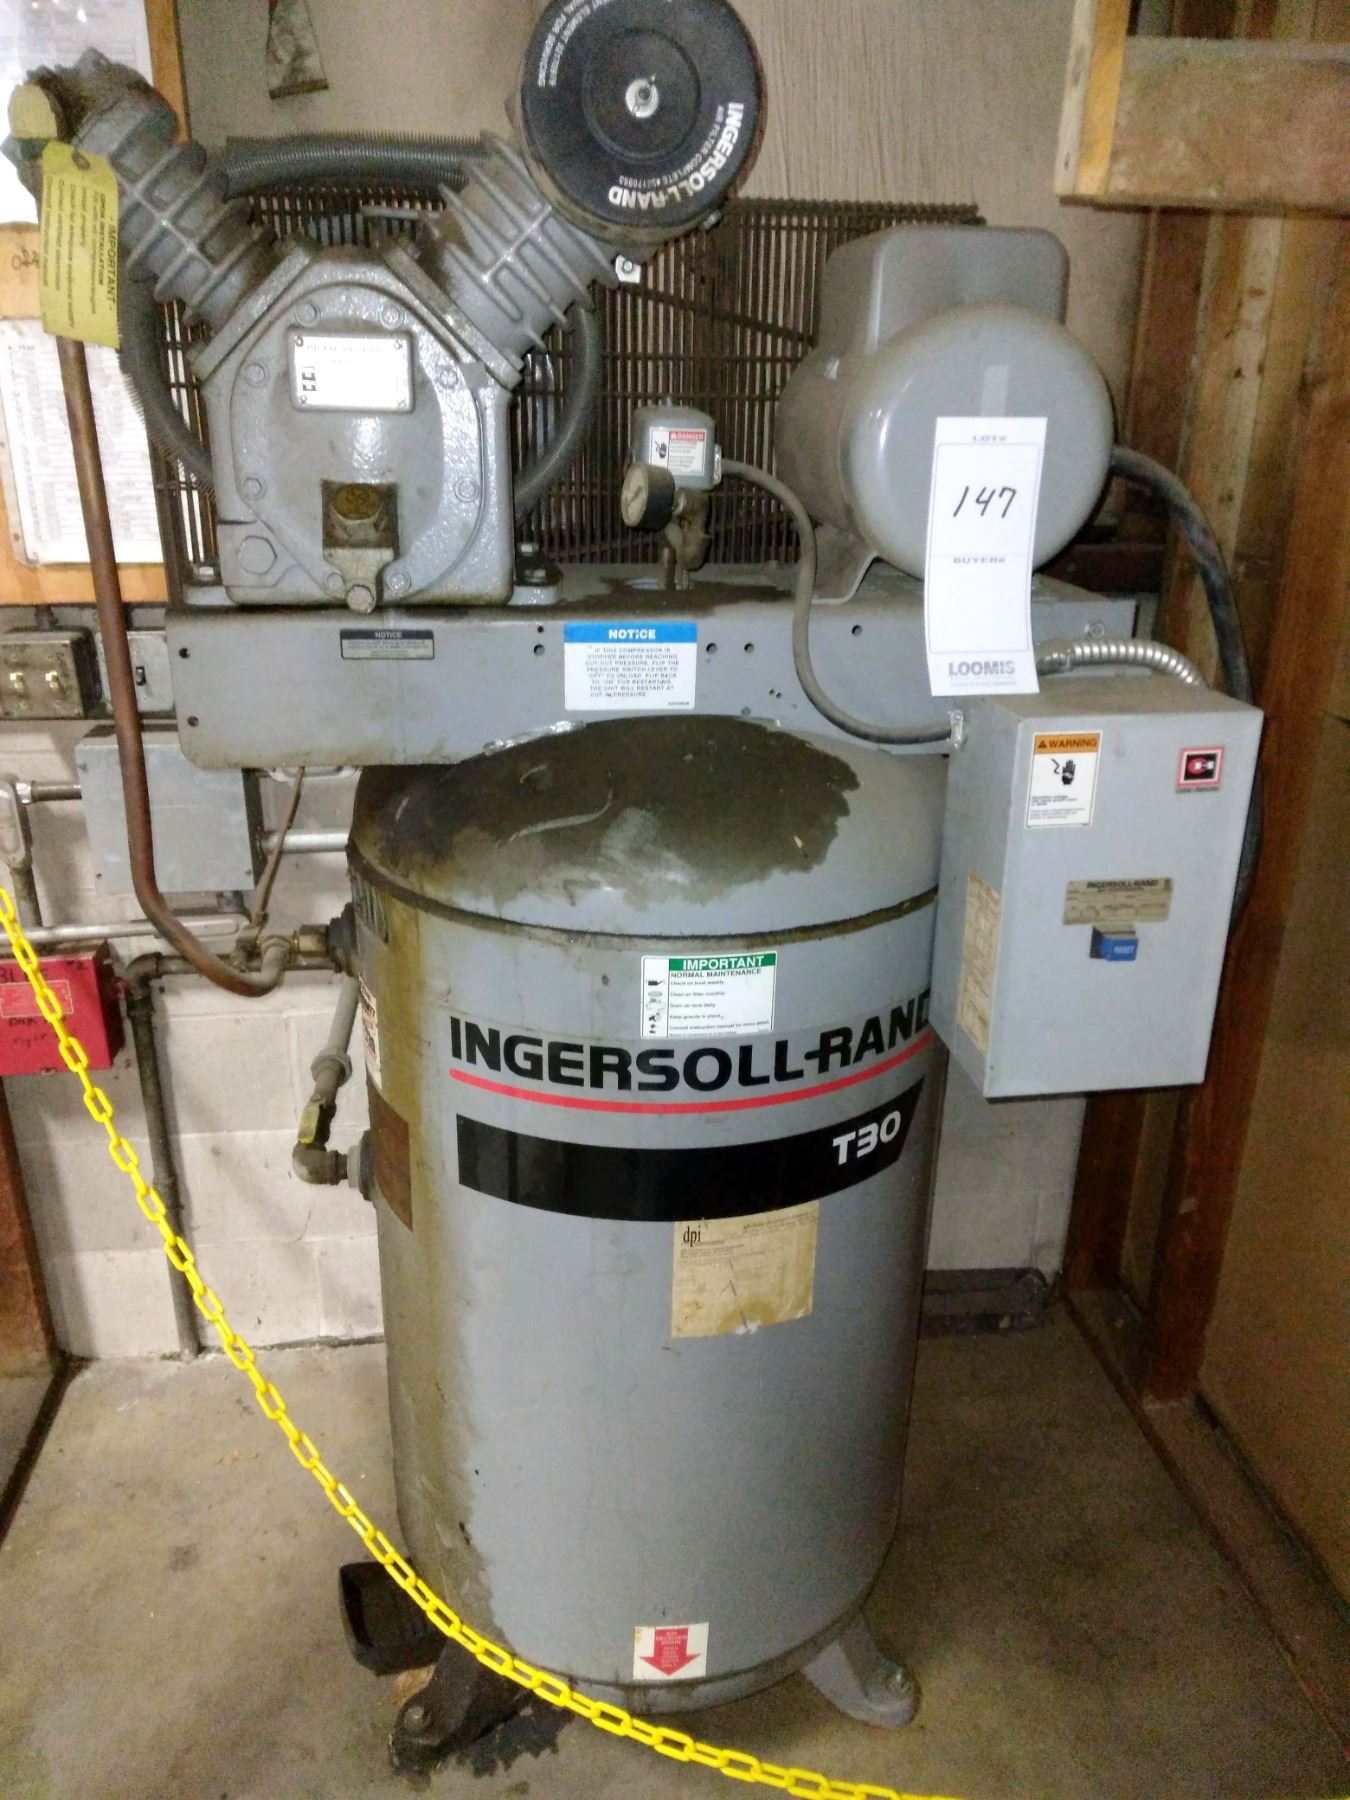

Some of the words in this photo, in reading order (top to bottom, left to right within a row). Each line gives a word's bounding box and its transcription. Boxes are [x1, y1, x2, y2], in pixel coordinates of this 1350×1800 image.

[608, 102, 744, 210] INGERSOLL-RAND
[106, 224, 116, 304] IMPORTANT
[952, 486, 1016, 518] 147
[608, 629, 656, 639] NOTICE
[948, 660, 1015, 676] LOOMIS
[1049, 738, 1096, 748] WARNING
[682, 956, 765, 970] IMPORTANT
[707, 968, 761, 978] MAINTENANCE
[450, 986, 932, 1092] INGERSOLL-RAND
[832, 1110, 902, 1166] T30
[682, 1224, 702, 1247] dpi
